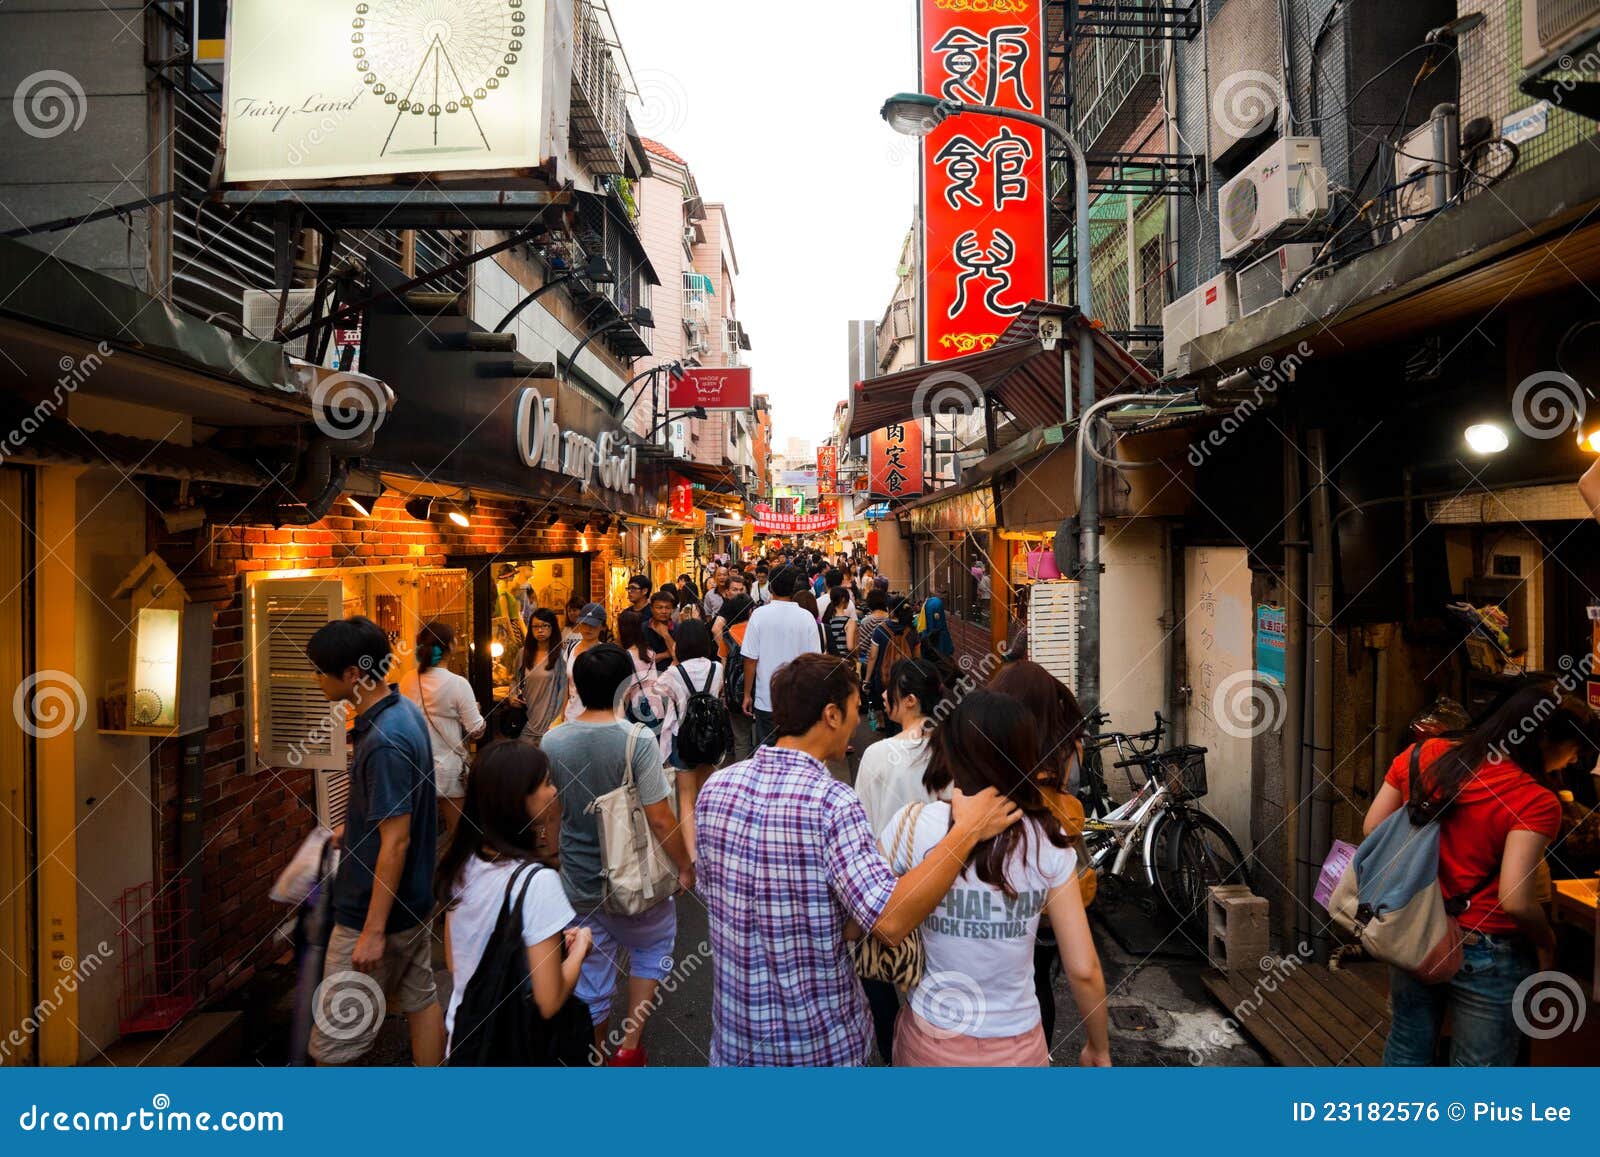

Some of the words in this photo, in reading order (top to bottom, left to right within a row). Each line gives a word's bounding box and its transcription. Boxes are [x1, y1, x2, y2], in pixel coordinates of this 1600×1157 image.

[234, 97, 290, 132] Fairy
[292, 89, 365, 113] Land
[517, 387, 560, 473] Oh
[563, 430, 598, 494] my
